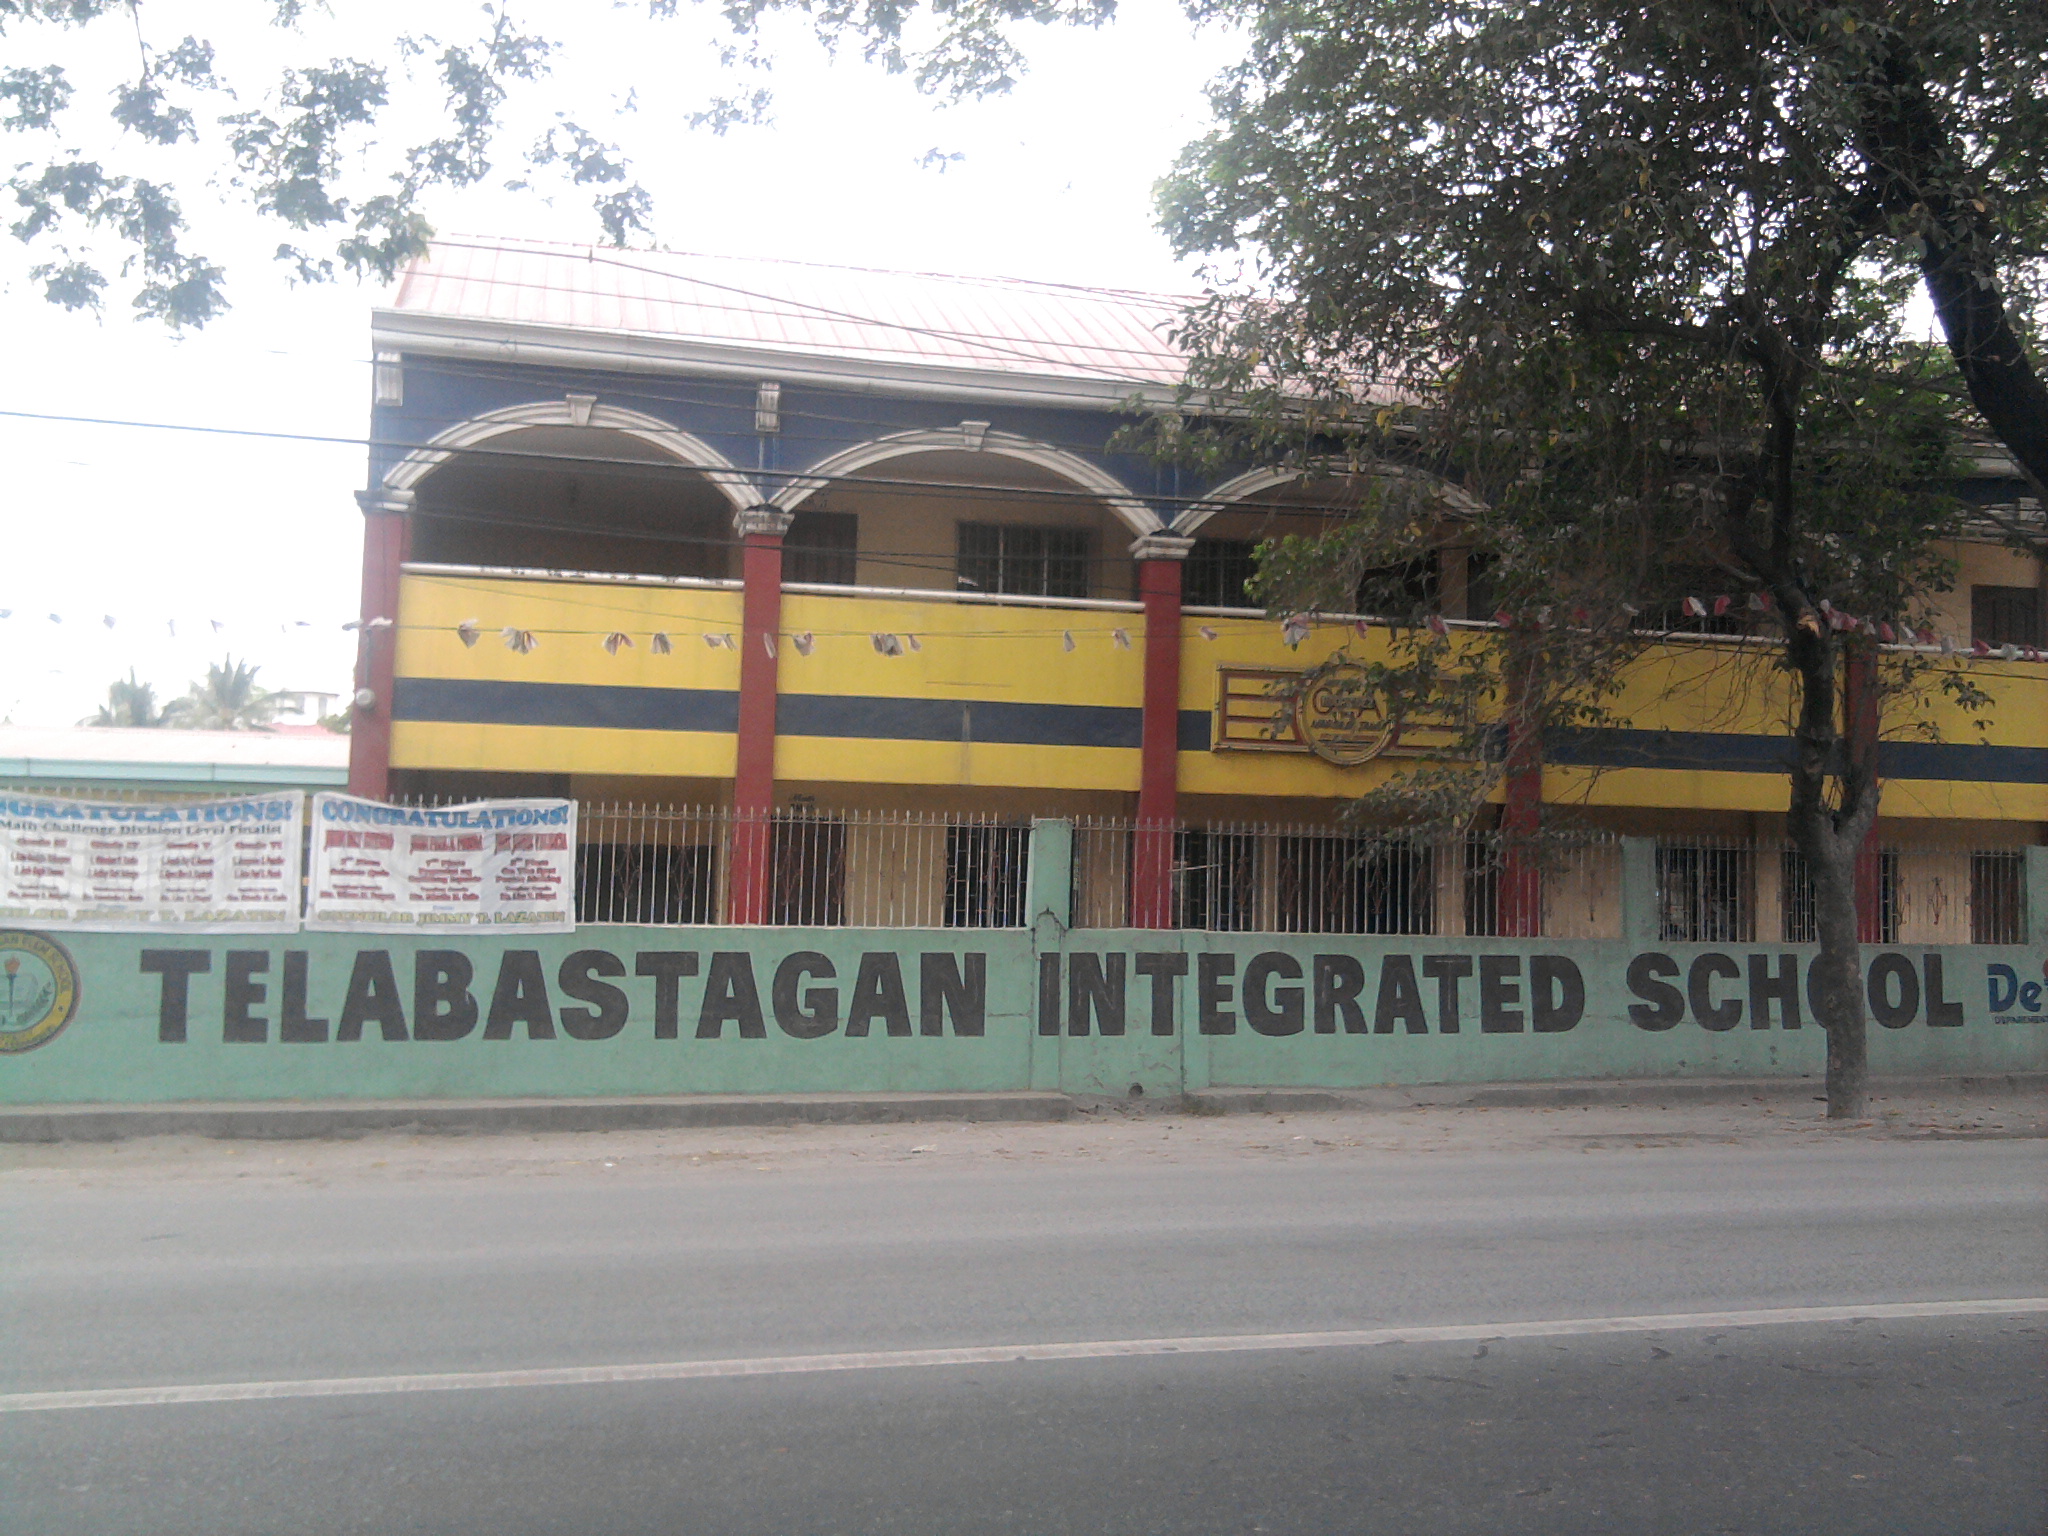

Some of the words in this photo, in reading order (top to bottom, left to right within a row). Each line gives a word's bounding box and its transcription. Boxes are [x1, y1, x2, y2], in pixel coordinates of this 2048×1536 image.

[42, 821, 117, 837] Challenge
[120, 824, 182, 837] Division
[322, 801, 569, 829] CONGRATULATIONS!
[140, 949, 985, 1043] TELABASTAGAN
[1038, 950, 1586, 1037] INTEGRATED
